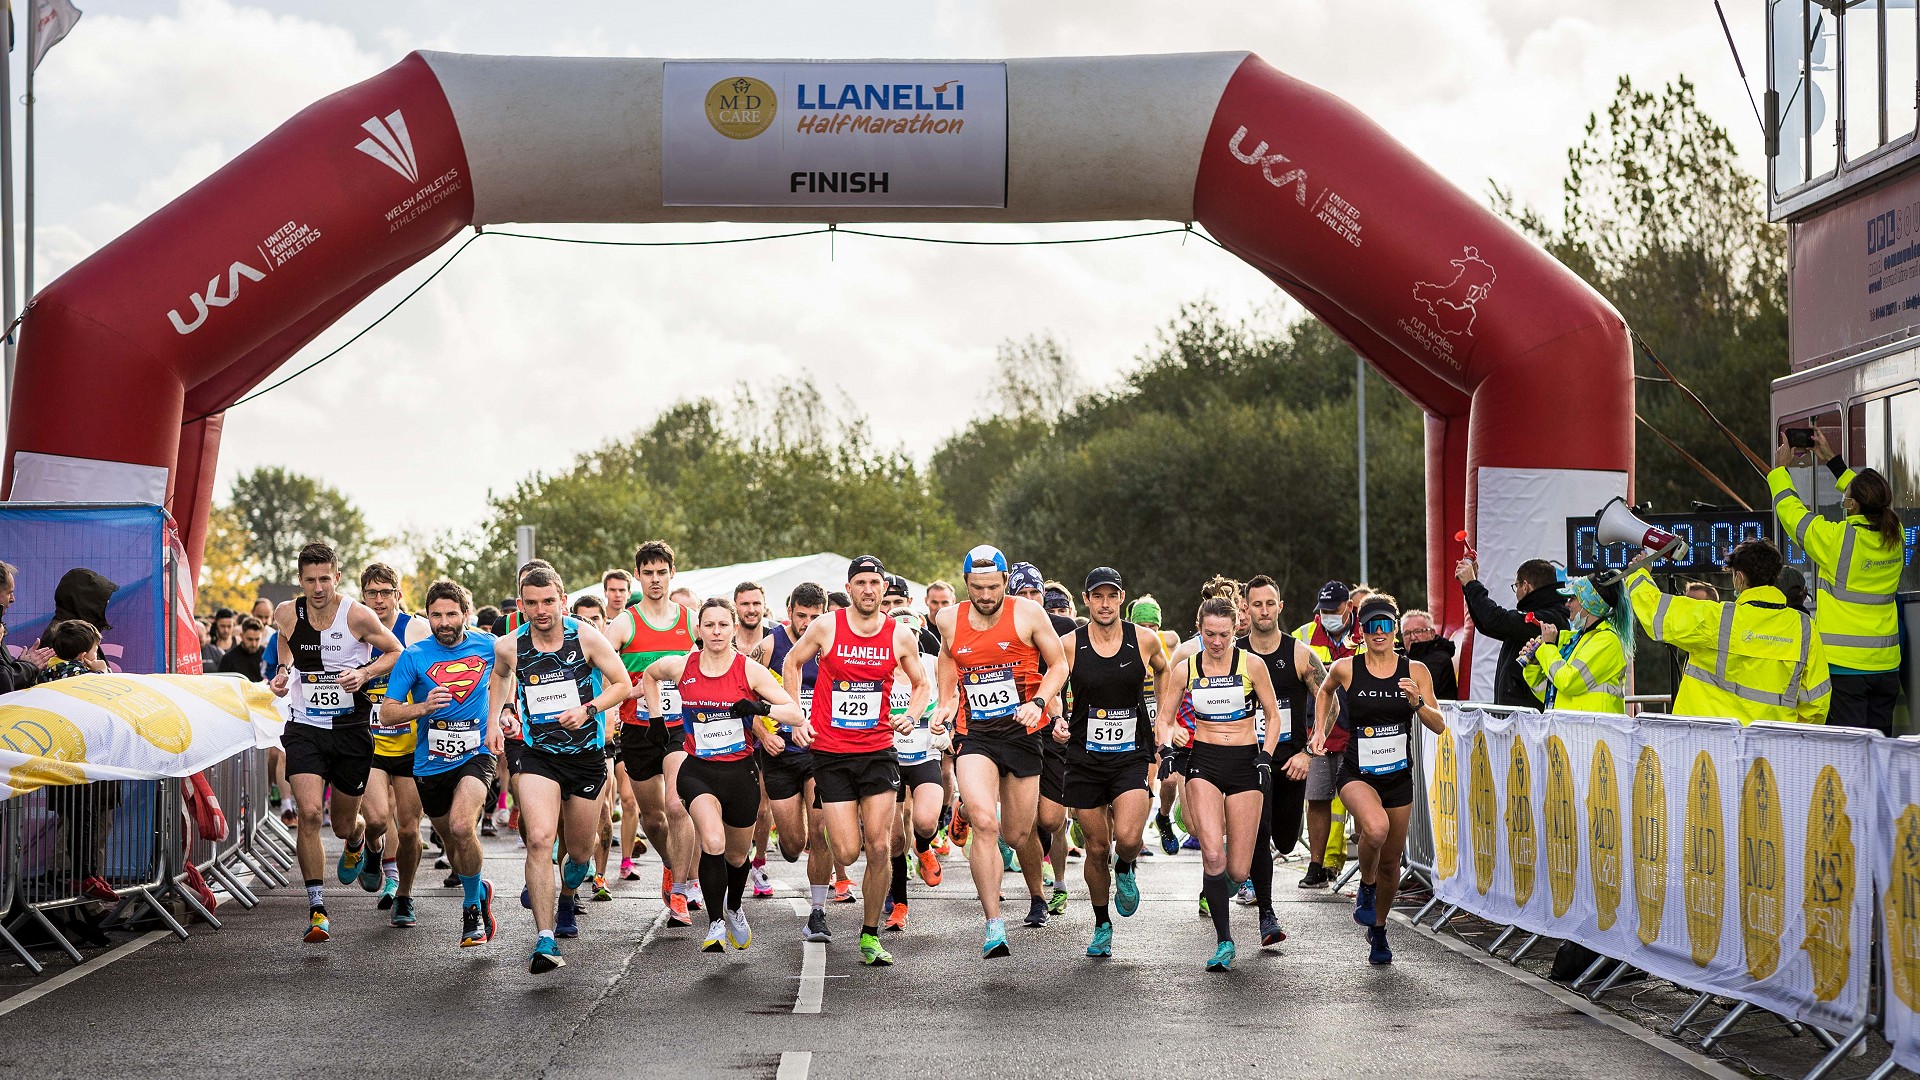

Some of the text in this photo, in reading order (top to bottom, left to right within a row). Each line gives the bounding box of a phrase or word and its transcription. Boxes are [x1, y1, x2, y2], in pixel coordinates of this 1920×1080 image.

[797, 81, 964, 110] LLANELLI
[719, 110, 761, 122] CARE
[797, 113, 964, 134] Half Marathon
[790, 171, 889, 193] FINISH
[385, 167, 459, 222] WELSH ATHLETICS
[389, 179, 462, 234] ATHLETAU CYMRU
[1328, 192, 1361, 220] UNITED
[1322, 202, 1363, 235] KINGDOM
[263, 220, 297, 248] UNITED
[1316, 211, 1362, 248] ATHLETICS
[269, 224, 311, 258] KINGDOM
[275, 229, 322, 267] ATHLETICS
[166, 261, 267, 335] UKA
[1397, 318, 1462, 371] rhedeg cymru
[1410, 315, 1454, 354] run wales
[300, 644, 342, 652] PONTYPRIDD
[836, 644, 890, 660] LLANELLI
[980, 672, 1004, 680] LLANELLI
[310, 692, 340, 706] 458
[536, 693, 568, 702] GRIFFITHS
[970, 690, 1010, 707] 1043
[839, 702, 868, 716] 429
[703, 730, 732, 738] HOWELLS
[1094, 728, 1124, 741] 519
[1375, 725, 1399, 733] LLANELLI
[436, 739, 466, 754] 553
[1371, 747, 1396, 755] HUGHES
